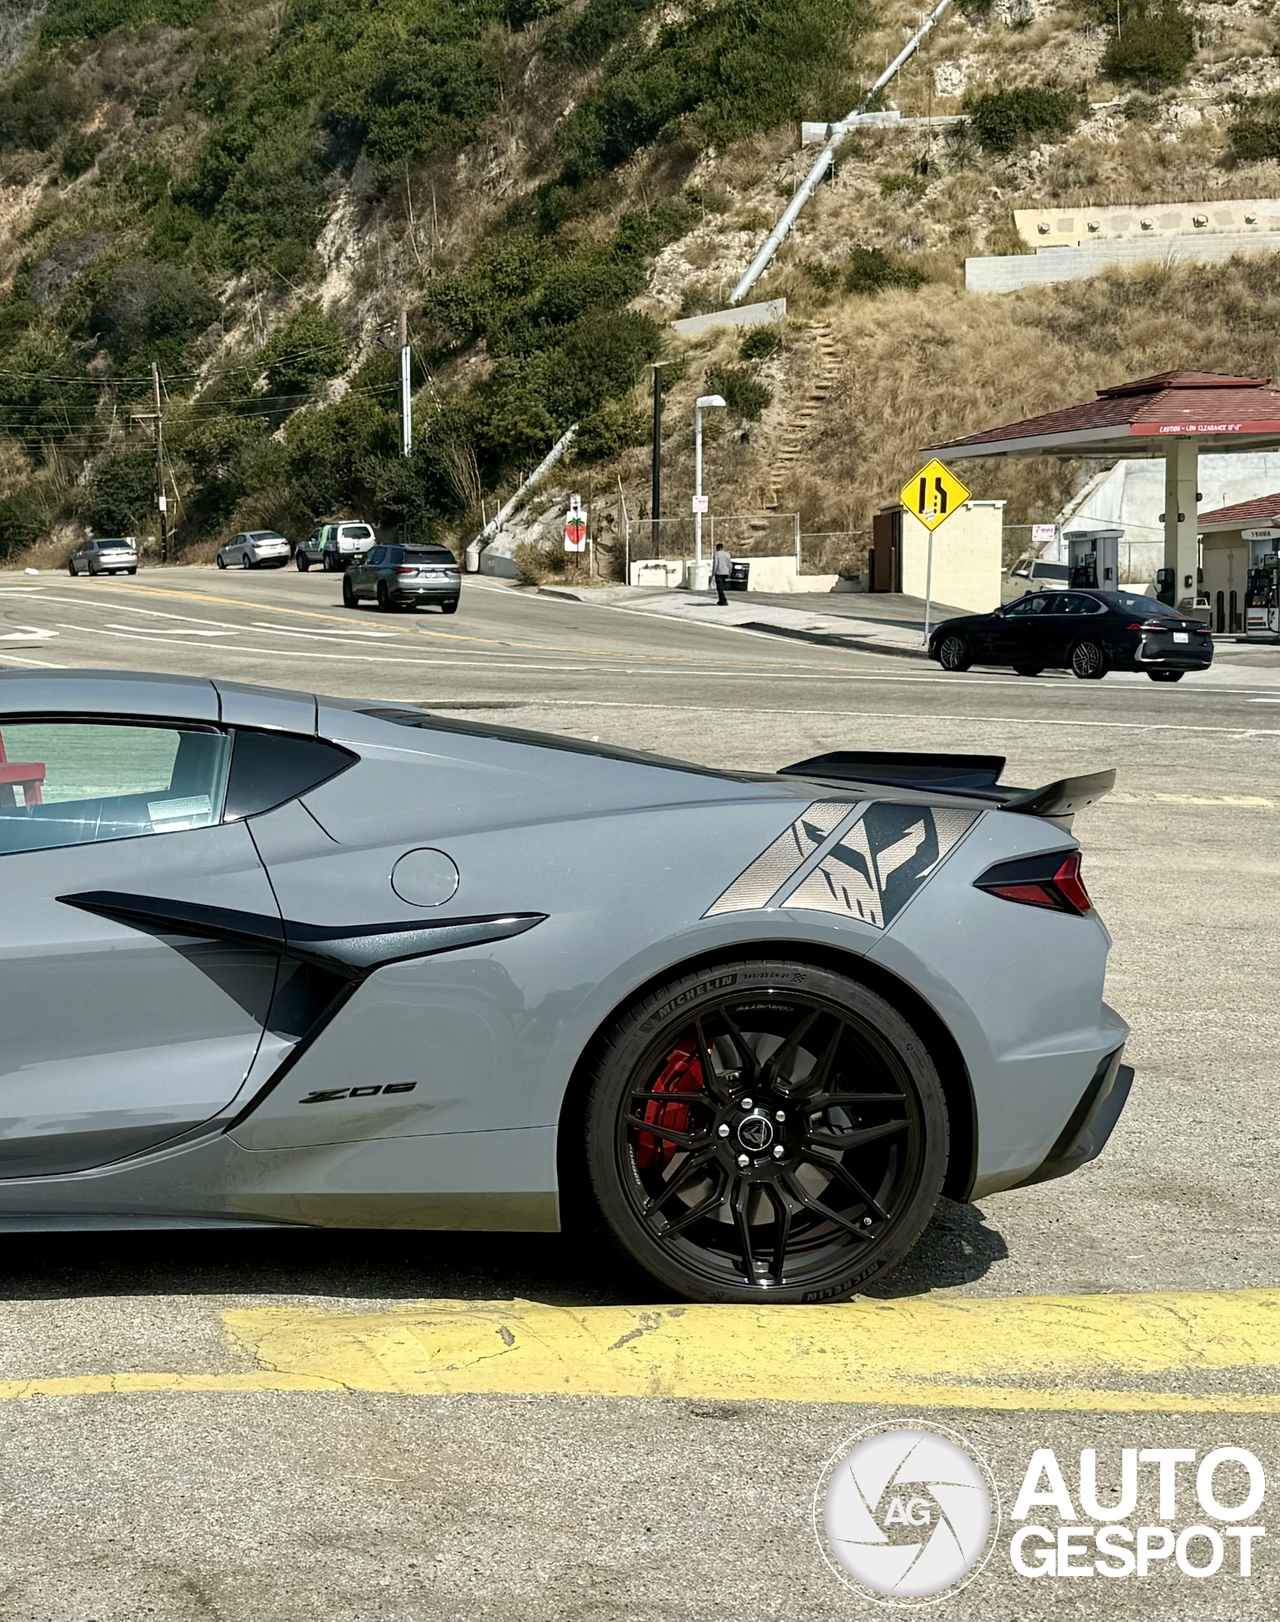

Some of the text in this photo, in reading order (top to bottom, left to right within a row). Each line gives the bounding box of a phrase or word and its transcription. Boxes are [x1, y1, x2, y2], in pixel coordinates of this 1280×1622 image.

[1159, 425, 1181, 433] CAUTION
[1186, 424, 1197, 432] LOW
[1198, 424, 1227, 432] CLEARANCE
[658, 975, 733, 1018] MICHELIN
[299, 1082, 418, 1104] Z06
[807, 1262, 879, 1301] MICHELIN
